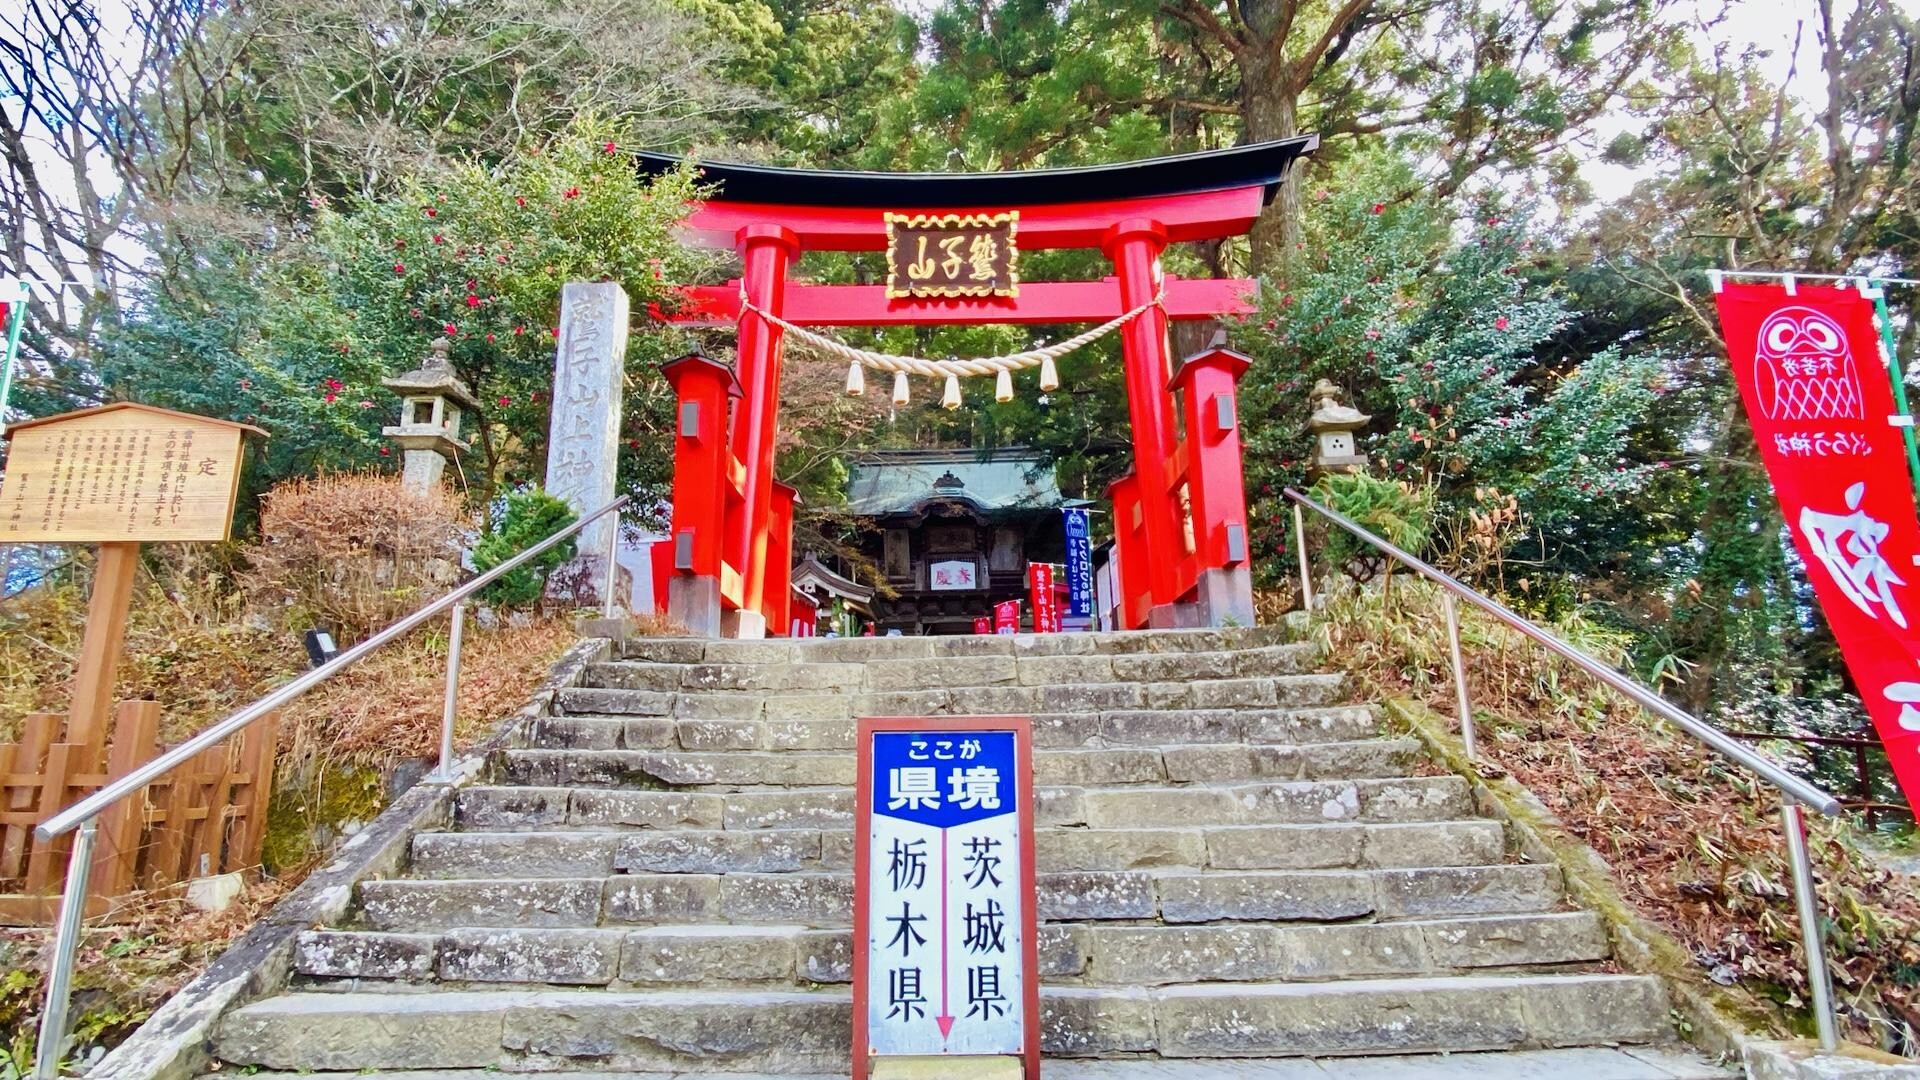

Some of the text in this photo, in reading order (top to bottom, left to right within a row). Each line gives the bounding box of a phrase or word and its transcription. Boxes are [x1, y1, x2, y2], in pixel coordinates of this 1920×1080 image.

[197, 457, 218, 477] 定
[1036, 570, 1050, 633] 鷲子山上神
[909, 739, 982, 760] ここが
[887, 765, 1001, 811] 県境
[885, 837, 928, 1023] 栃木県
[962, 836, 1006, 1022] 茨城県
